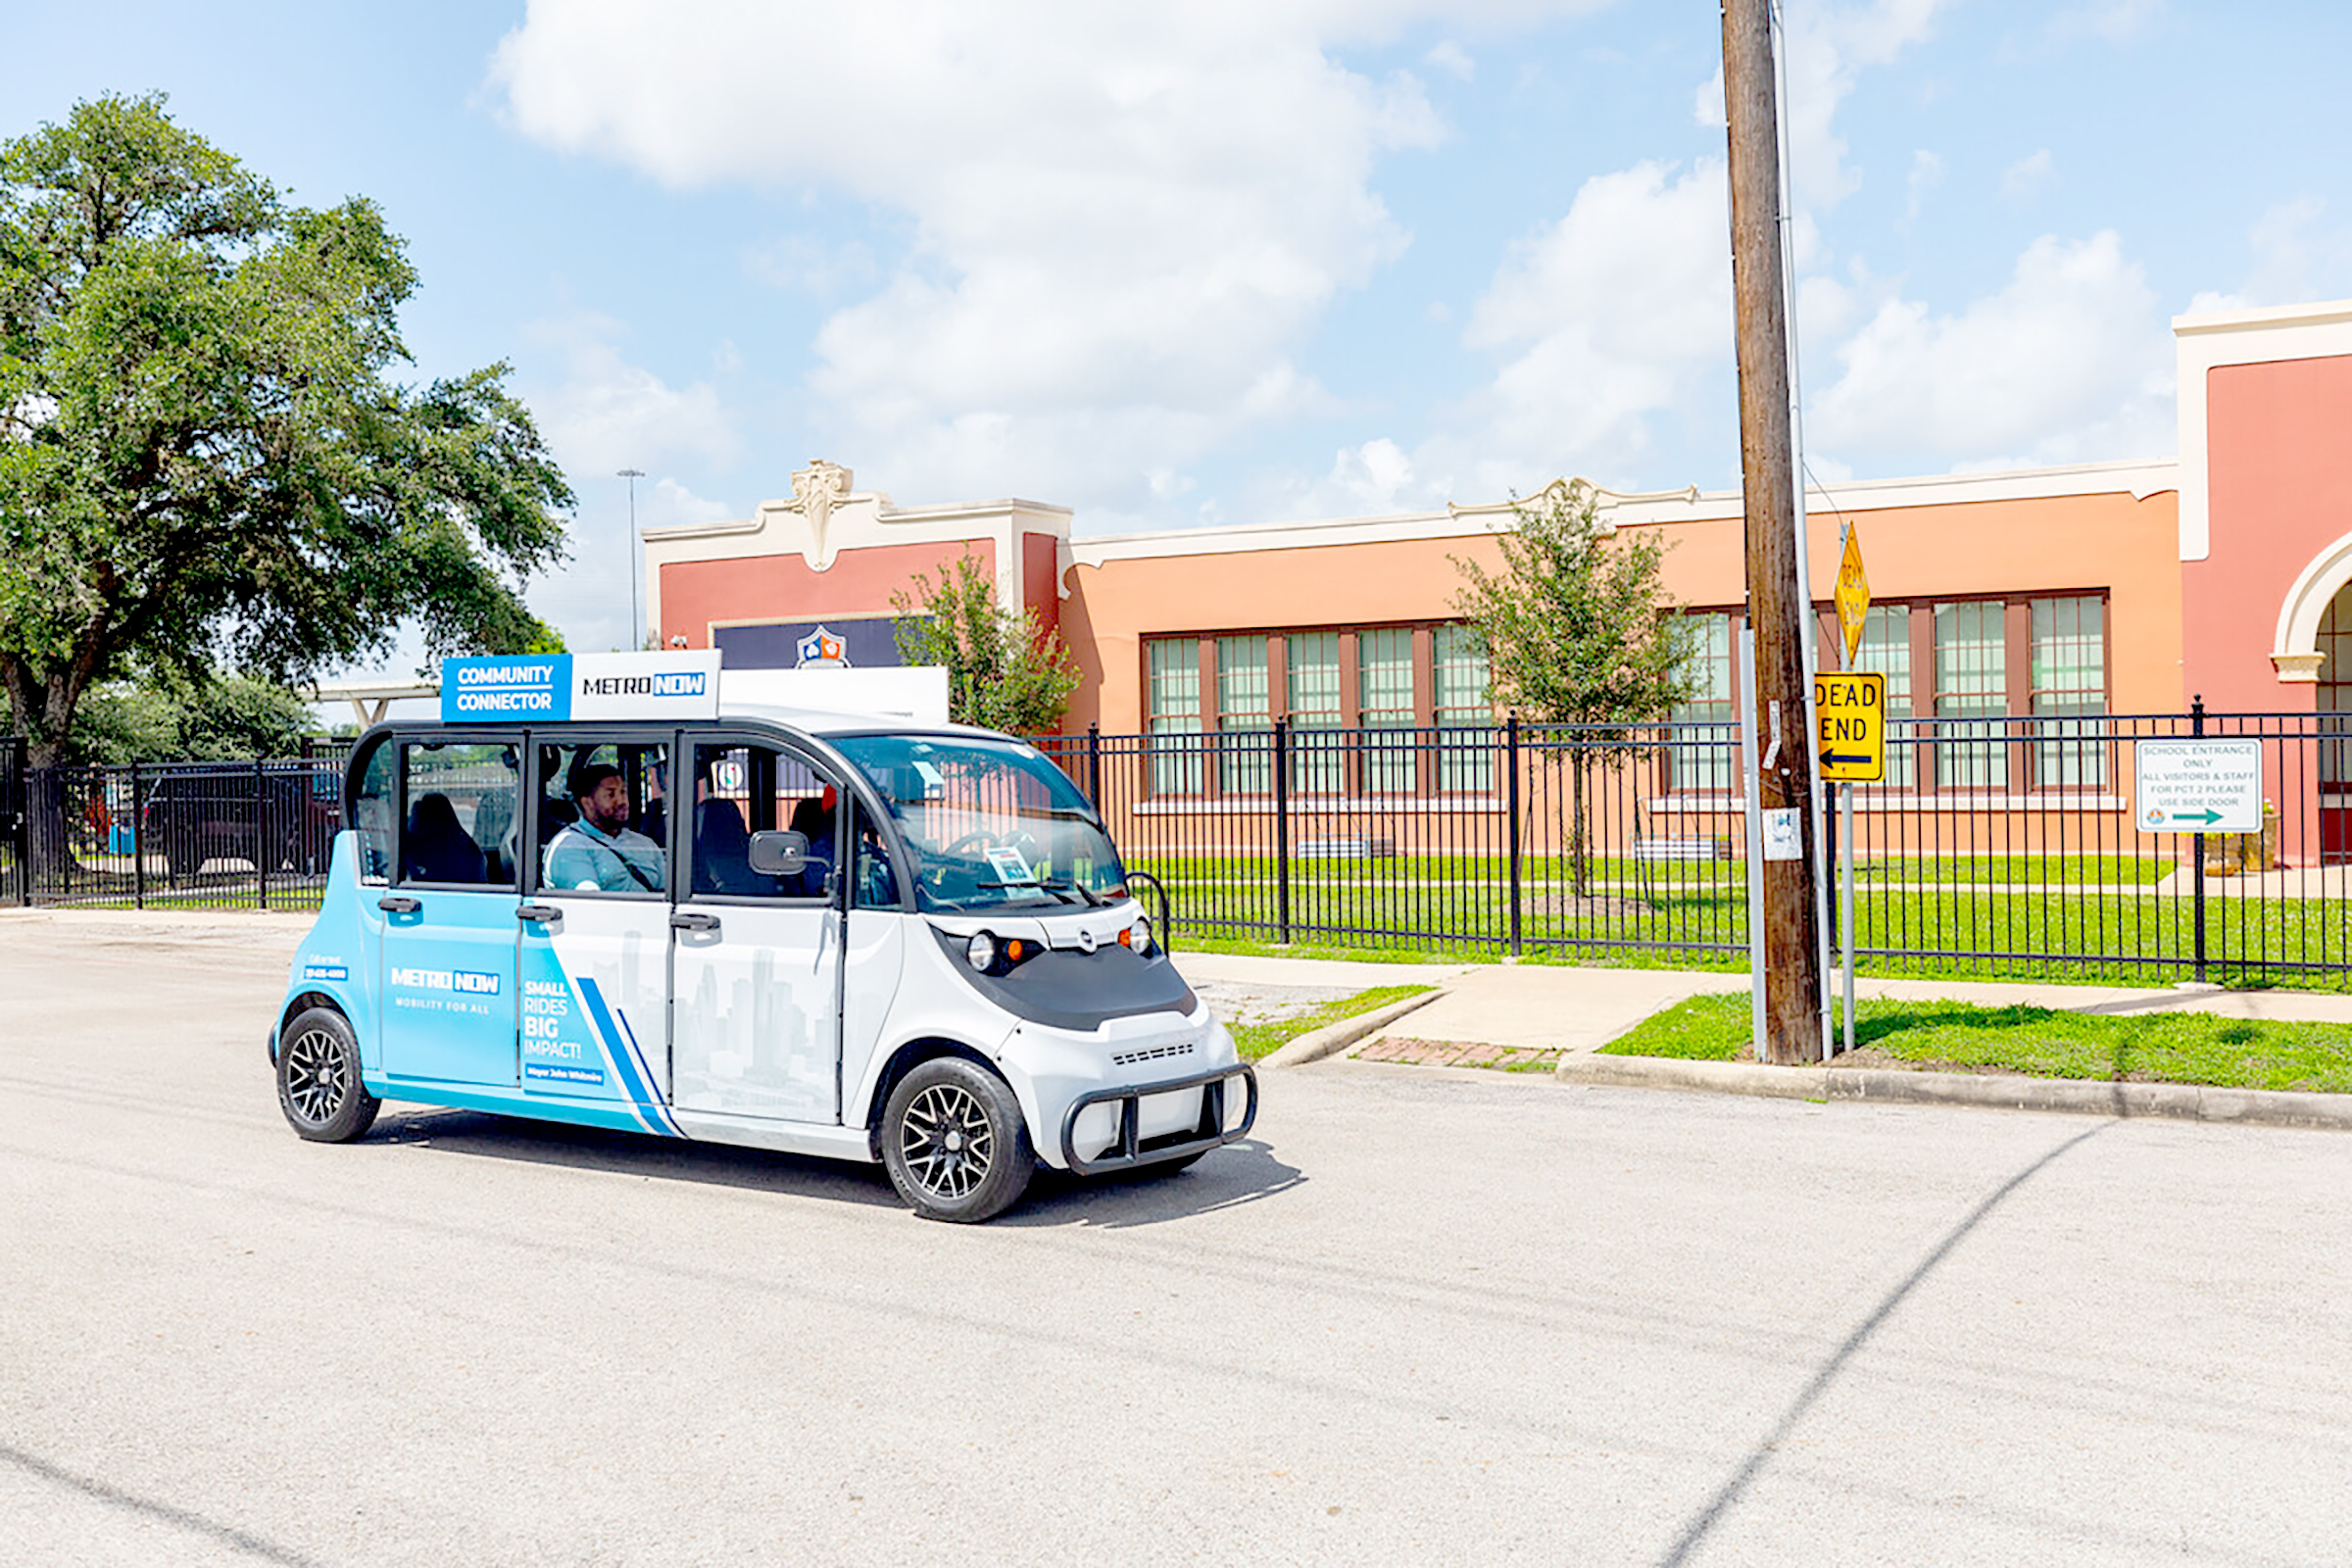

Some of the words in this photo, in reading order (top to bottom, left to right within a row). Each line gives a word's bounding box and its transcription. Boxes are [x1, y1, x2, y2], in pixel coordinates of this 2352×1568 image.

[457, 664, 554, 684] COMMUNITY
[457, 692, 552, 710] CONNECTOR
[1814, 683, 1876, 707] DEAD
[1821, 717, 1867, 741] END
[2143, 746, 2189, 756] SCHOOL
[2191, 745, 2253, 756] ENTRANCE
[2182, 759, 2213, 768] ONLY
[2142, 771, 2160, 781] ALL
[2163, 771, 2210, 781] VISITORS
[2223, 771, 2254, 781] STAFF
[2150, 785, 2172, 794] FOR
[2175, 785, 2194, 794] PCT
[2196, 785, 2203, 794] 2
[2205, 785, 2245, 794] PLEASE
[2158, 798, 2180, 807] USE
[2181, 798, 2205, 807] SIDE
[2208, 798, 2239, 807] DOOR
[524, 980, 567, 998] SMALL
[395, 997, 443, 1010] MOBILITY
[446, 1002, 467, 1012] FOR
[470, 1004, 489, 1015] ALL
[524, 997, 568, 1016] RIDES
[524, 1015, 559, 1039] BIG
[524, 1039, 581, 1059] IMPACT!
